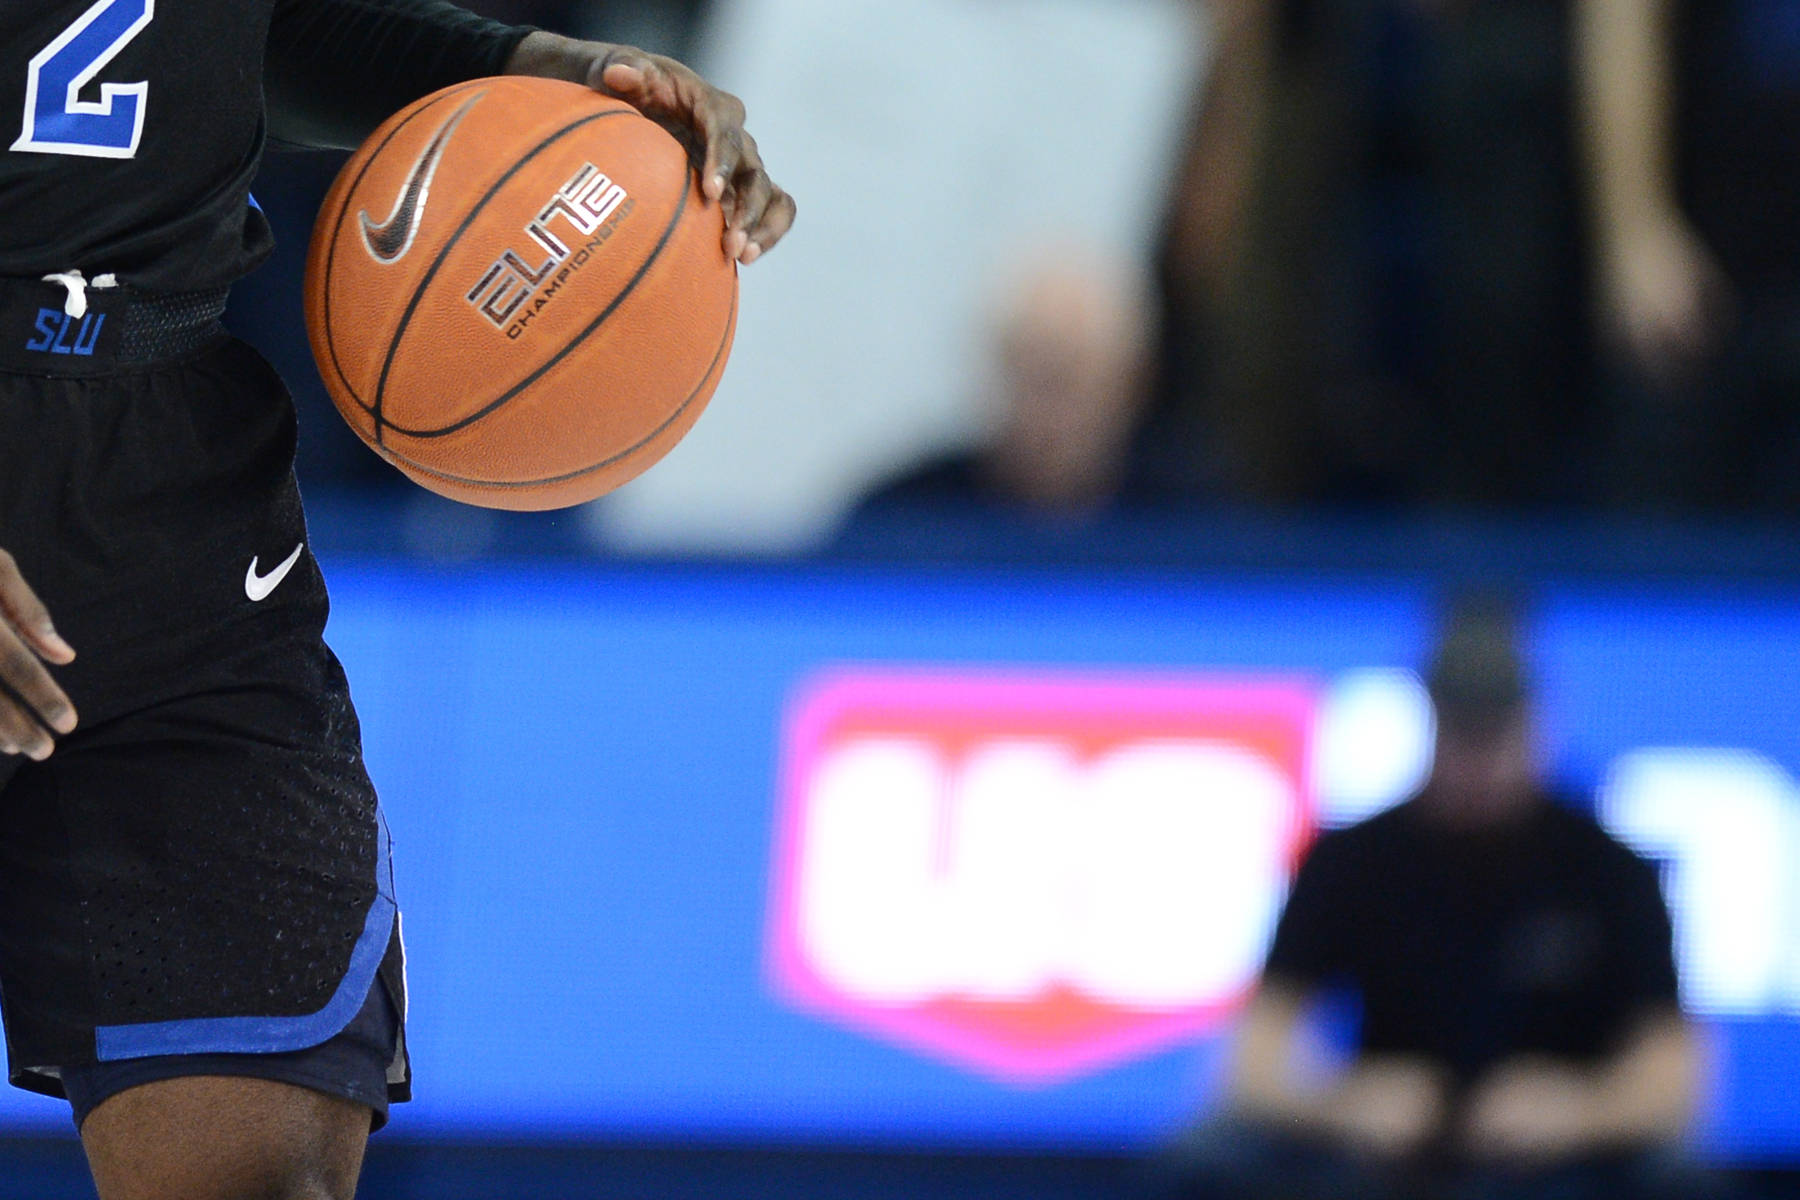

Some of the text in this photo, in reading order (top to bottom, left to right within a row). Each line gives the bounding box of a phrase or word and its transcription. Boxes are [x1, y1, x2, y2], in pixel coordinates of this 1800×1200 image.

[464, 161, 627, 330] ELITE
[506, 198, 635, 340] CHAMPIONSHIP
[26, 308, 106, 356] SLU
